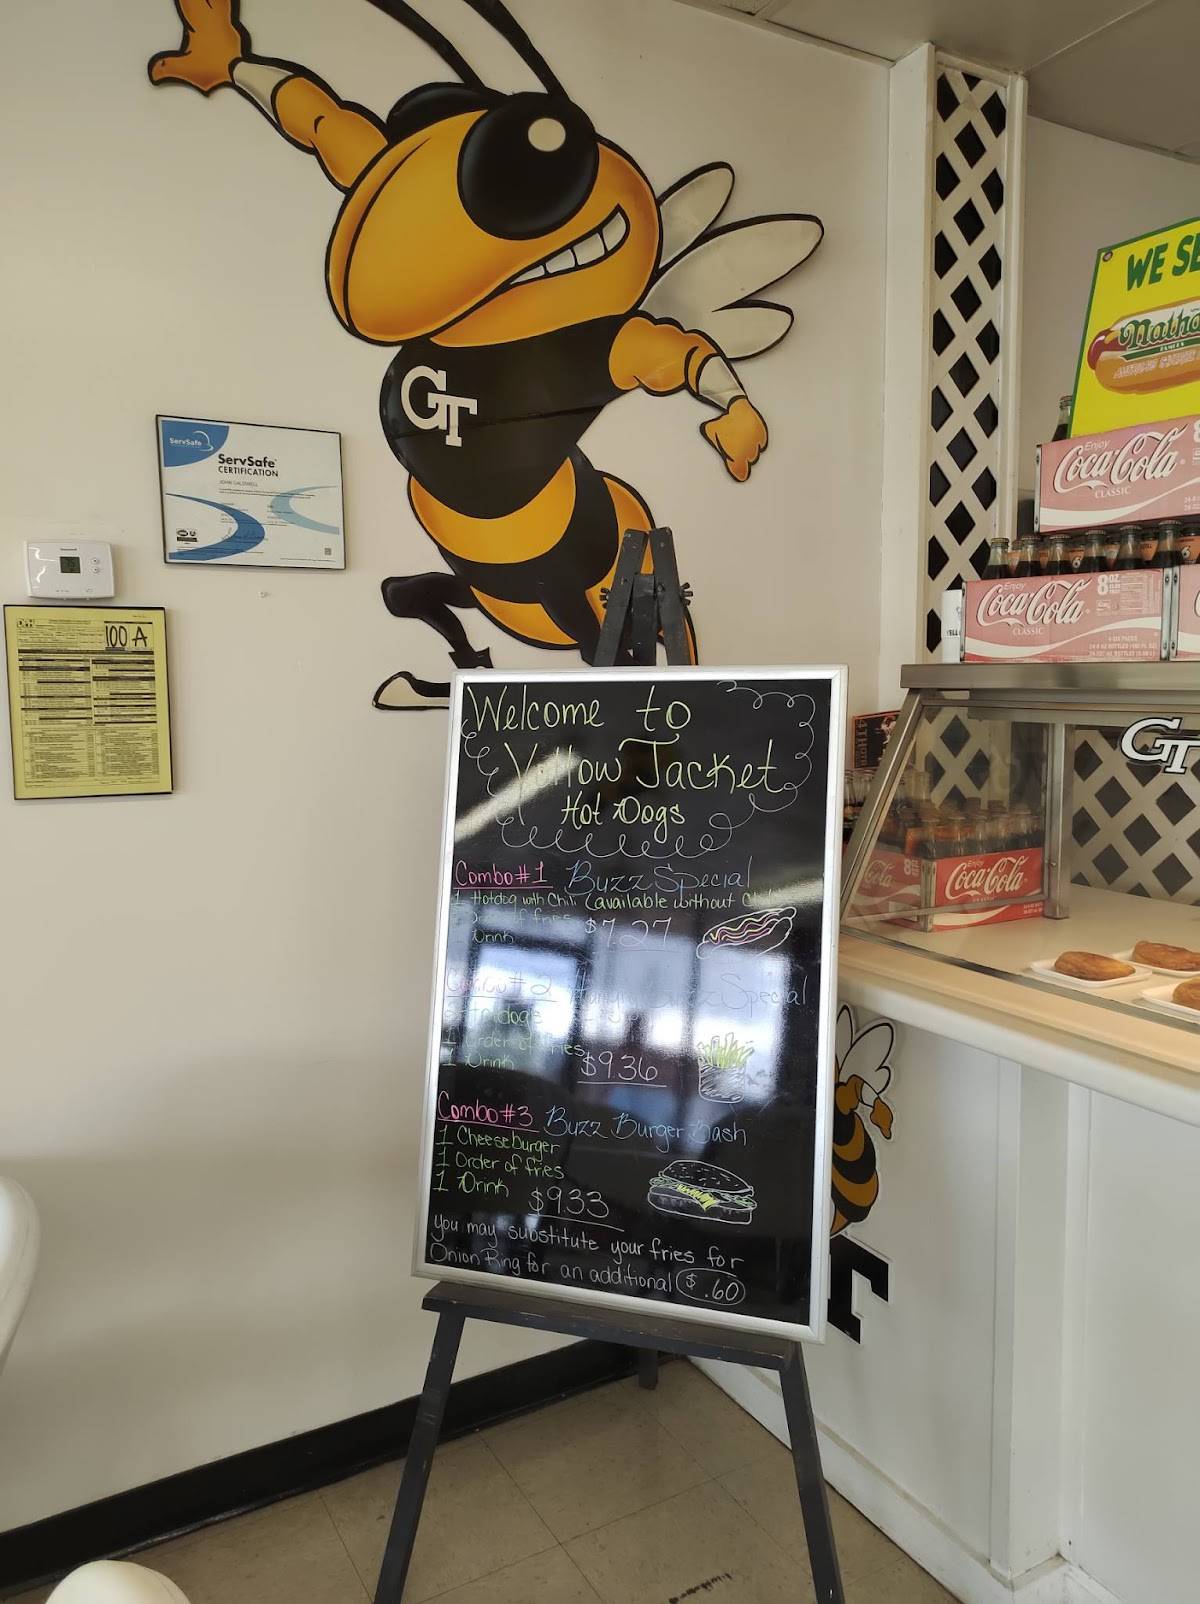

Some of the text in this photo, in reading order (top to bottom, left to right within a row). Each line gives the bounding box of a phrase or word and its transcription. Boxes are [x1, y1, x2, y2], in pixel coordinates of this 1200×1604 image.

[1127, 243, 1168, 291] WE
[401, 365, 478, 447] GT
[169, 437, 202, 447] ServSafe
[218, 453, 276, 468] ServSafe
[1053, 423, 1188, 493] Coca-Cola
[1084, 439, 1111, 451] Enjoy
[218, 465, 279, 478] CERTIFICATION
[1094, 486, 1131, 499] CLASSIC
[976, 577, 1092, 627] Coca-Cola
[1003, 583, 1026, 592] Enjoy
[1097, 575, 1109, 595] 8
[105, 625, 128, 647] 100
[132, 626, 148, 647] A
[1012, 627, 1044, 636] CLASSIC
[467, 685, 692, 732] Welcome to
[618, 733, 784, 794] Jacket
[1120, 716, 1200, 774] GT
[561, 790, 686, 843] Hot Dogs
[564, 860, 651, 895] Buzz
[653, 856, 753, 894] Special
[945, 855, 1031, 900] Coca-Cola
[522, 892, 545, 906] with
[547, 892, 577, 907] Chili
[673, 892, 736, 910] without
[435, 1124, 454, 1145] 1
[543, 1105, 608, 1138] Buzz
[611, 1113, 685, 1153] Burger
[688, 1121, 747, 1146] Dash
[435, 1146, 565, 1179] 1 Order of fries
[432, 1170, 609, 1218] 1 Drink $9.33
[467, 1222, 499, 1249] may
[508, 1225, 600, 1251] substitute
[611, 1239, 645, 1265] your
[650, 1237, 695, 1264] fries
[706, 1246, 745, 1269] for
[430, 1242, 480, 1266] Onion
[480, 1247, 521, 1277] Ring
[526, 1251, 552, 1275] for
[560, 1264, 583, 1281] an
[590, 1264, 672, 1293] additional
